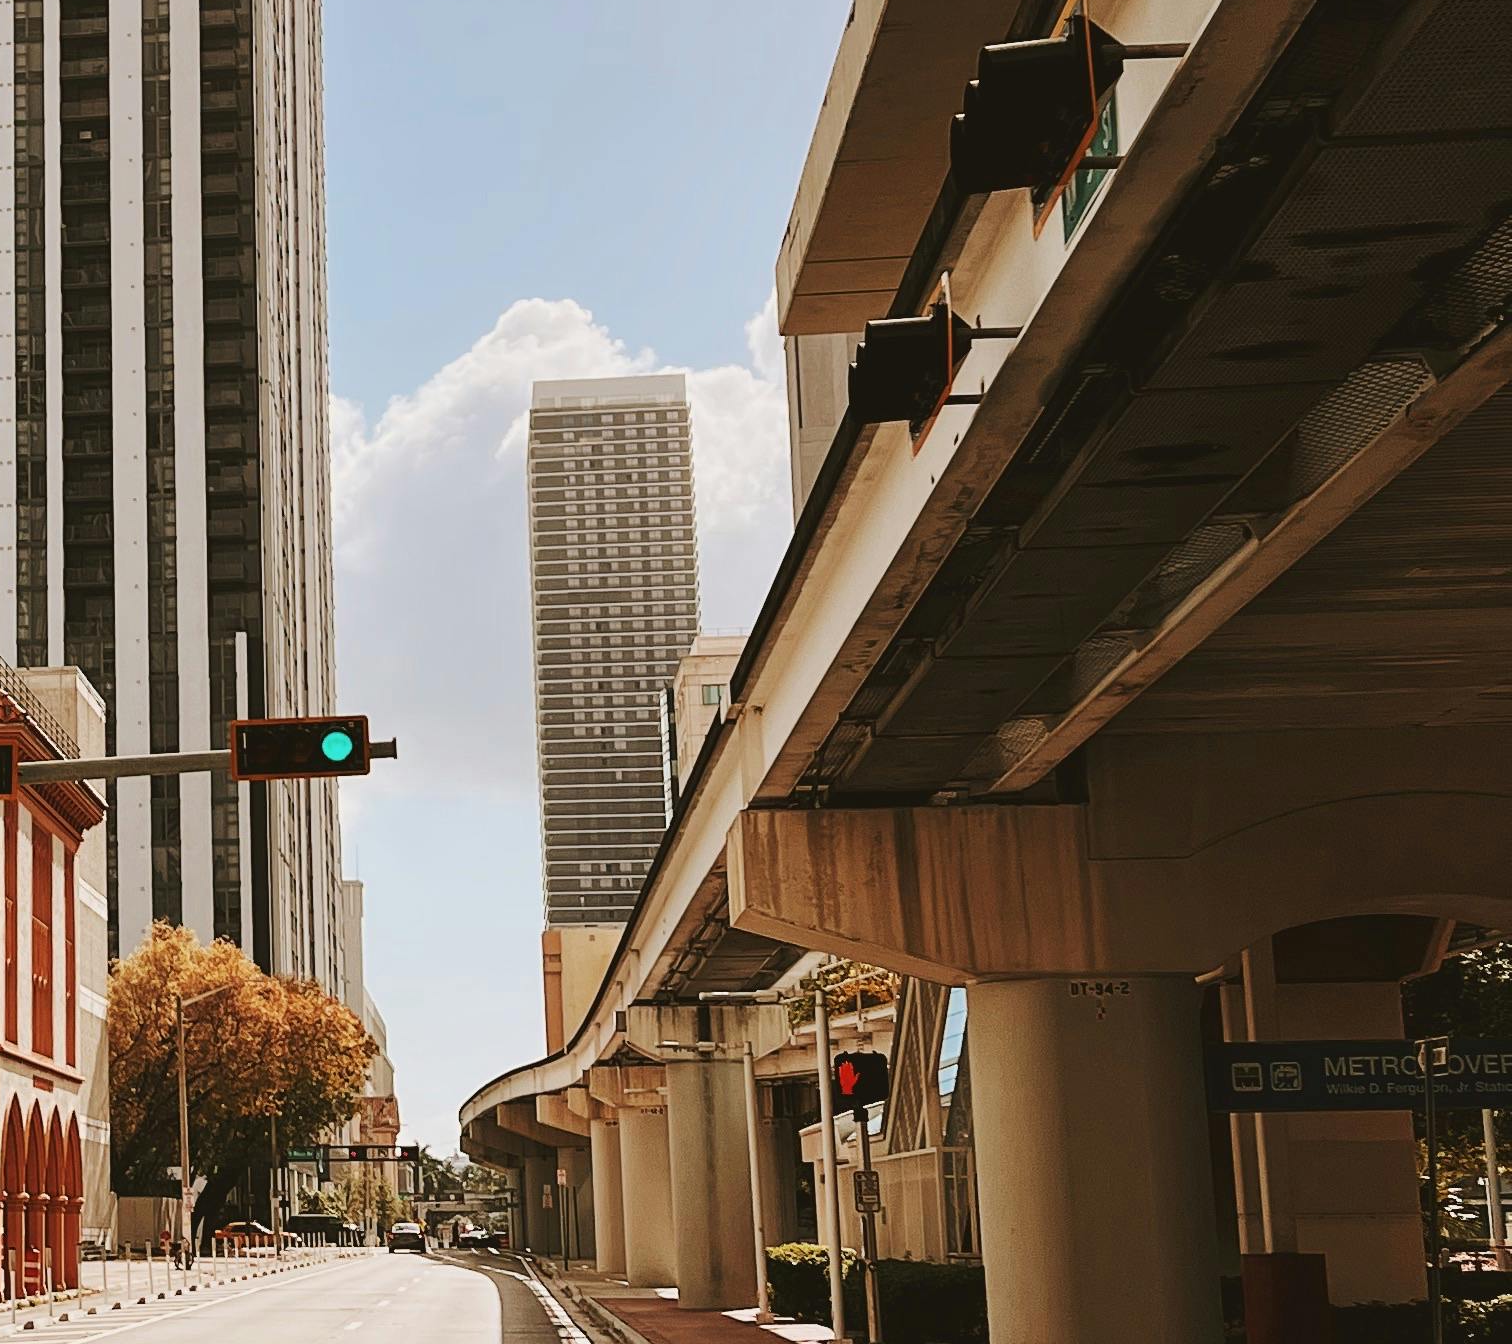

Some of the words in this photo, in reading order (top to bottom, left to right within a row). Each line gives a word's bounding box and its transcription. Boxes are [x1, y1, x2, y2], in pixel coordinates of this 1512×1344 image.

[1324, 1054, 1512, 1076] METROOVER
[1326, 1082, 1366, 1095] Wilkie
[1369, 1082, 1383, 1094] D.
[1387, 1081, 1453, 1096] Ferguon,
